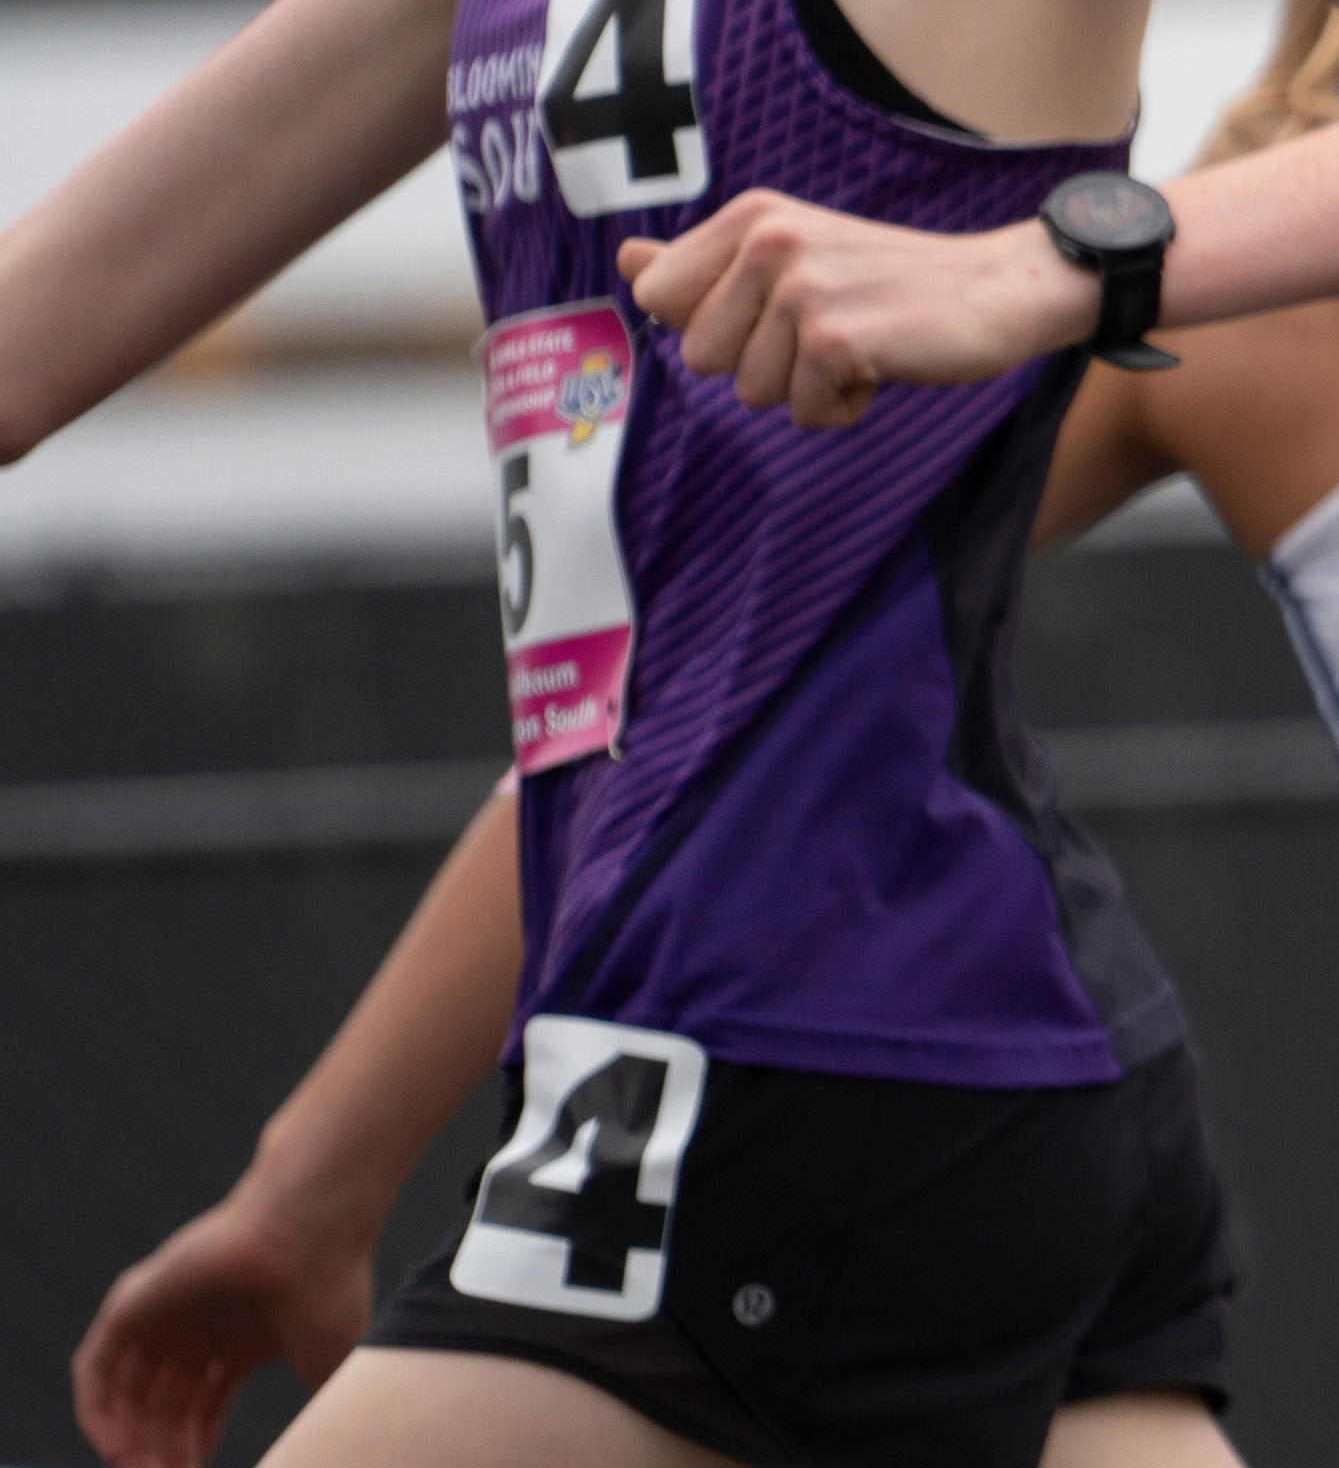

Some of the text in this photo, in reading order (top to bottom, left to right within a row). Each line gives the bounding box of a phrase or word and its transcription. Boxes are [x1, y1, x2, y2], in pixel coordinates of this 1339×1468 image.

[446, 43, 542, 116] BLOOMIN
[449, 108, 542, 215] SOU
[480, 1051, 670, 1295] 4
